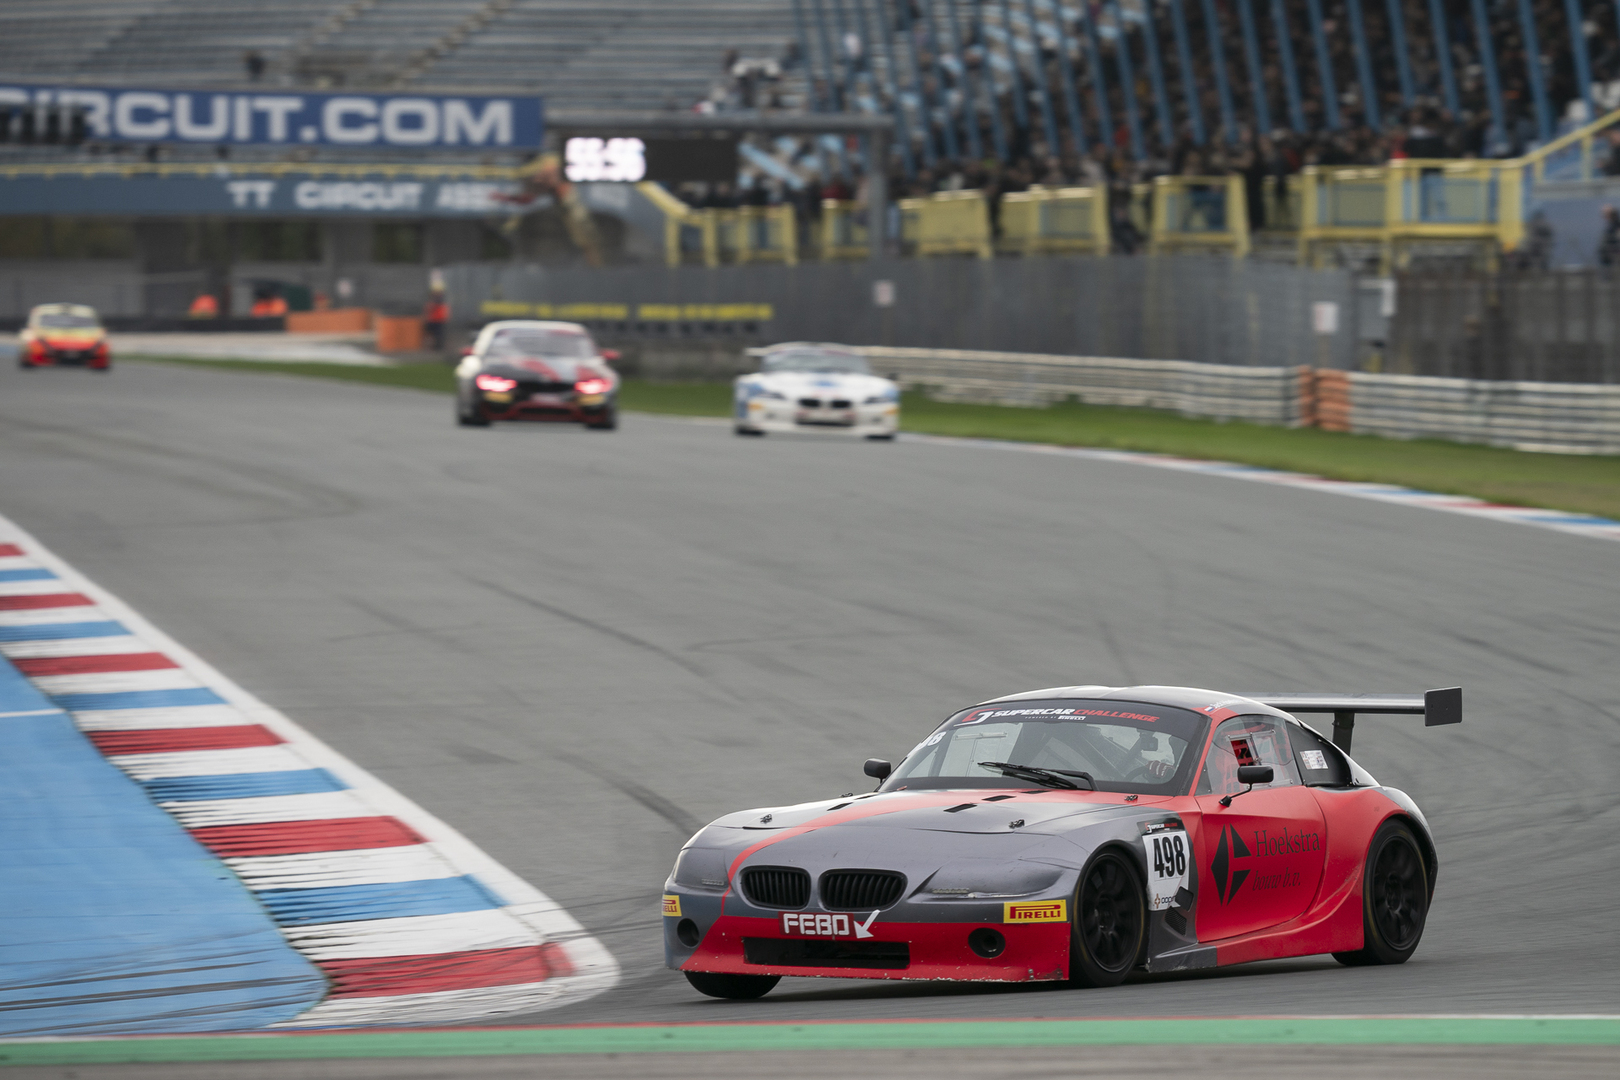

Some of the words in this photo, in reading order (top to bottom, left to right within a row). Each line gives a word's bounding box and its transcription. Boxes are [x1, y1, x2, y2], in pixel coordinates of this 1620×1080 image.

[226, 181, 277, 209] TT
[991, 708, 1075, 718] SUPERCAR
[1073, 709, 1160, 723] CHALLENGE
[1254, 826, 1321, 858] Hoekstra
[1153, 835, 1186, 878] 498
[1252, 870, 1282, 891] bouw
[1282, 867, 1301, 888] b.v.
[1009, 904, 1062, 919] PIRELLI
[783, 913, 850, 936] FEBO
